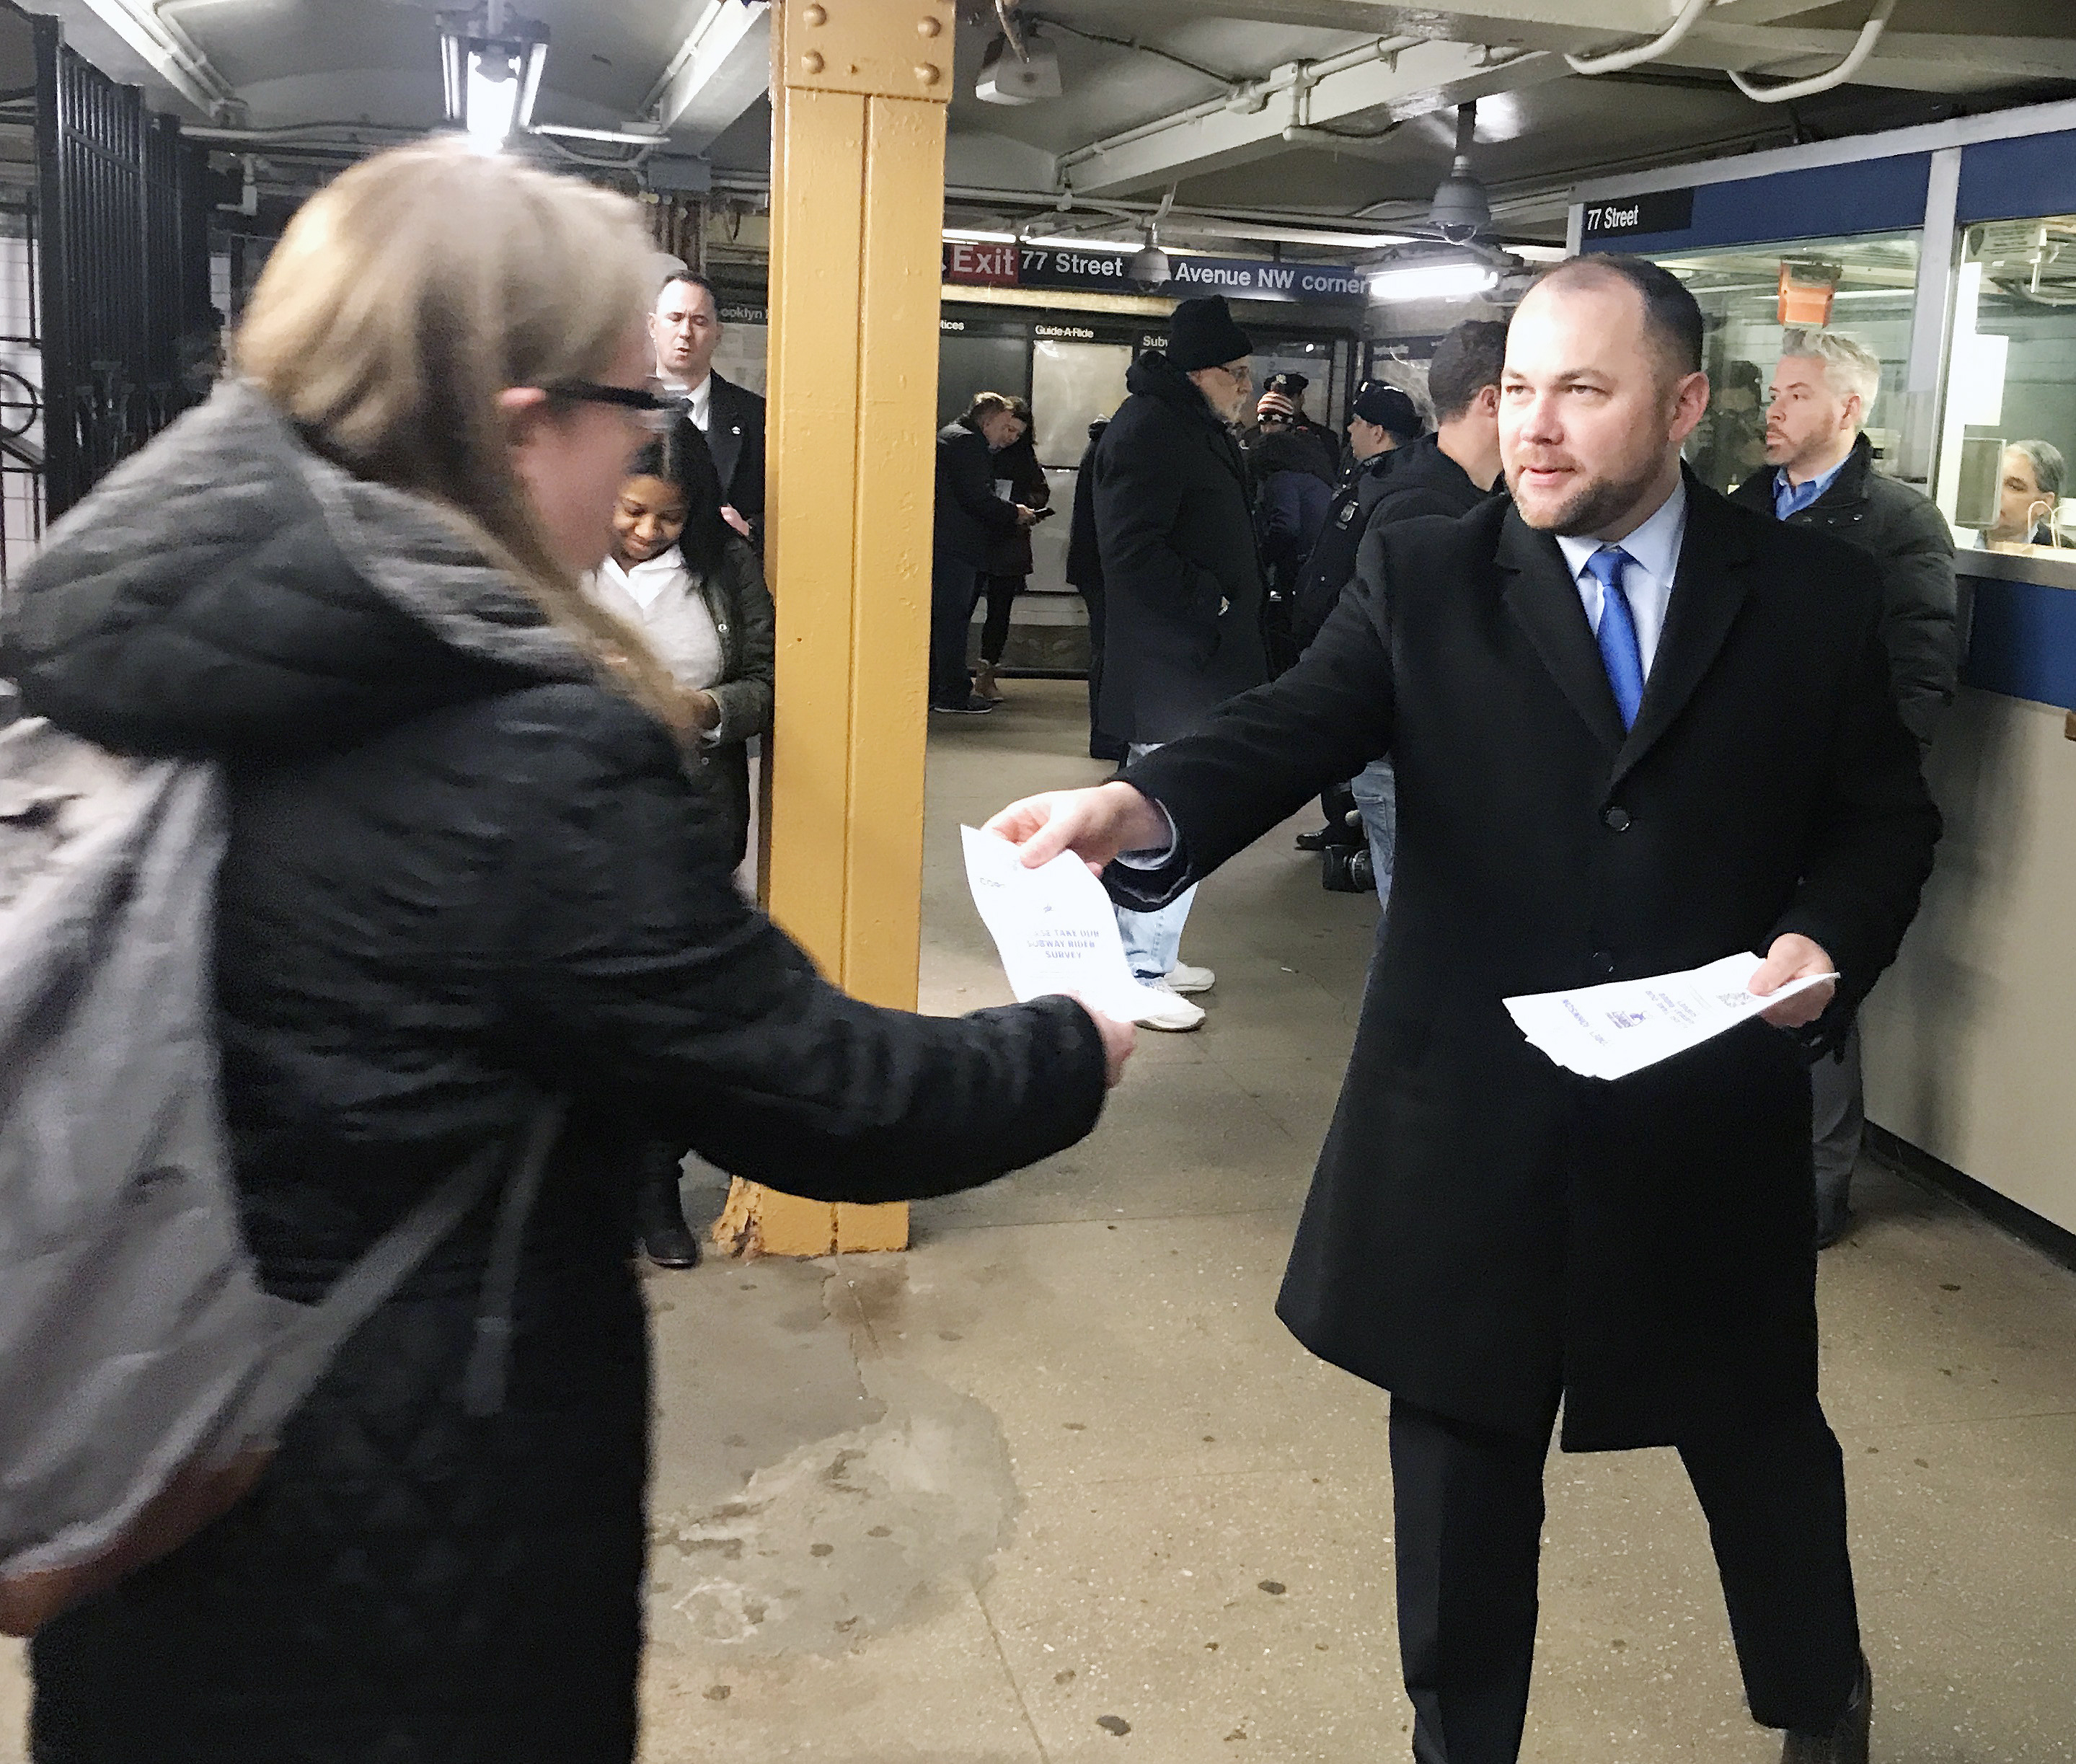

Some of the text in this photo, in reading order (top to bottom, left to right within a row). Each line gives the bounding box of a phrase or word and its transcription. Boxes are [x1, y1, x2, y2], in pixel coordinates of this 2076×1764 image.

[1588, 204, 1639, 231] 77 Street
[953, 245, 1015, 276] Exit
[1020, 250, 1123, 277] 77 Street
[1175, 262, 1369, 294] Avenue NW corner
[720, 306, 764, 321] ooklyn
[940, 319, 965, 331] tices
[1034, 325, 1095, 339] Guide-A-Ride
[1142, 335, 1168, 348] Sub
[1054, 929, 1077, 938] TAKE
[1068, 940, 1095, 948] RIDER
[1045, 950, 1082, 959] SURVEY
